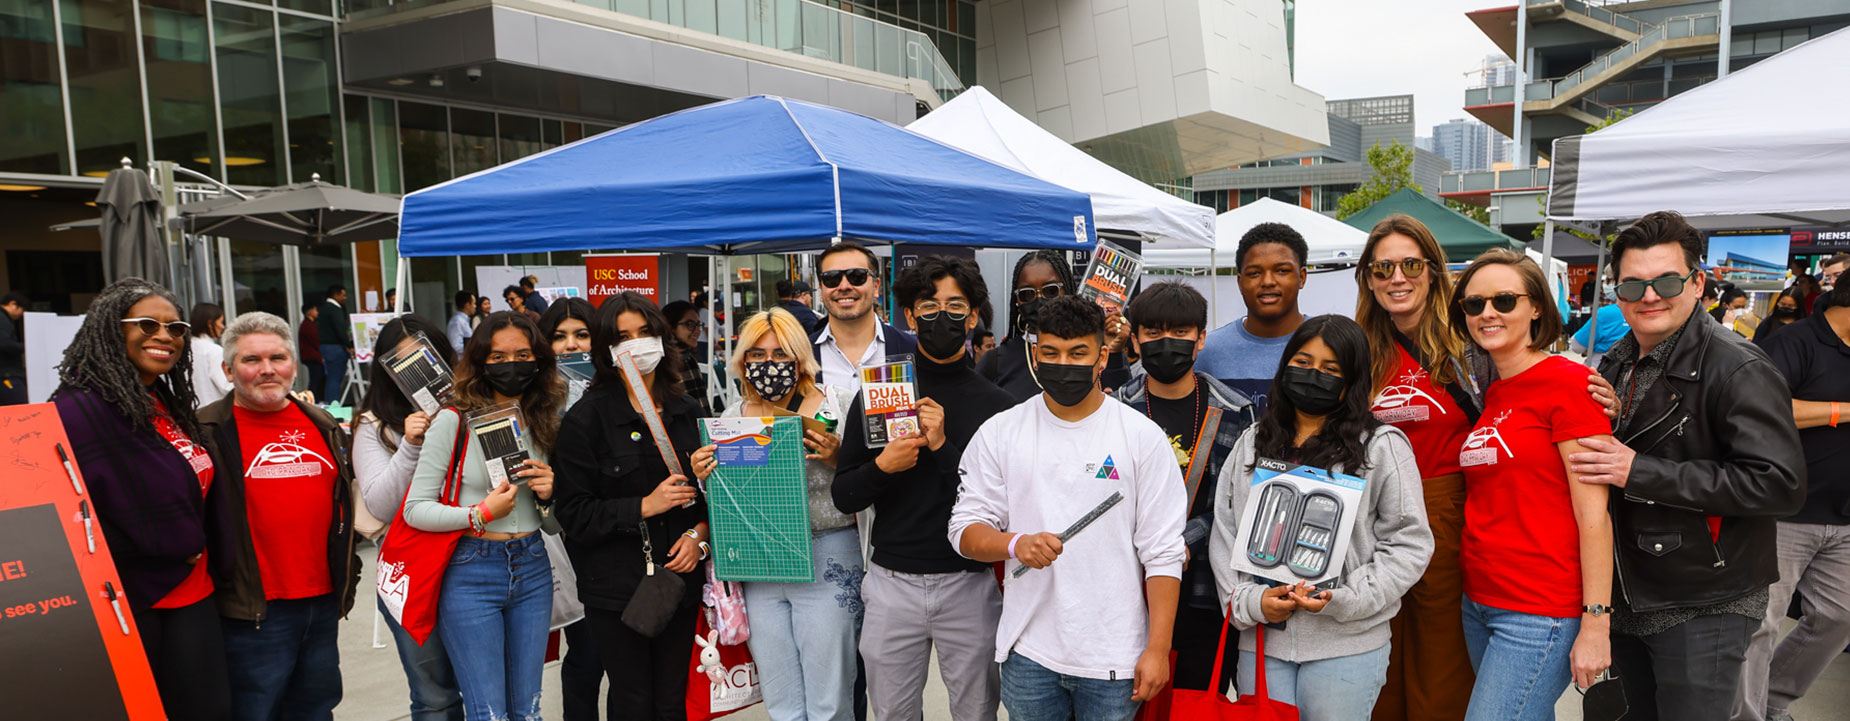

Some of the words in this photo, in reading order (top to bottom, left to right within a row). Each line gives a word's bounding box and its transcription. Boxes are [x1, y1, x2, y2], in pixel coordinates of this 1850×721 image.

[594, 269, 616, 280] USC
[618, 269, 648, 280] School
[1095, 265, 1127, 288] DUAL
[589, 285, 599, 295] of
[1092, 274, 1126, 294] BRUSH
[869, 385, 909, 400] DUAL
[870, 396, 910, 409] BRUSH
[0, 560, 27, 582] E!
[5, 603, 37, 618] see
[38, 595, 78, 615] you.
